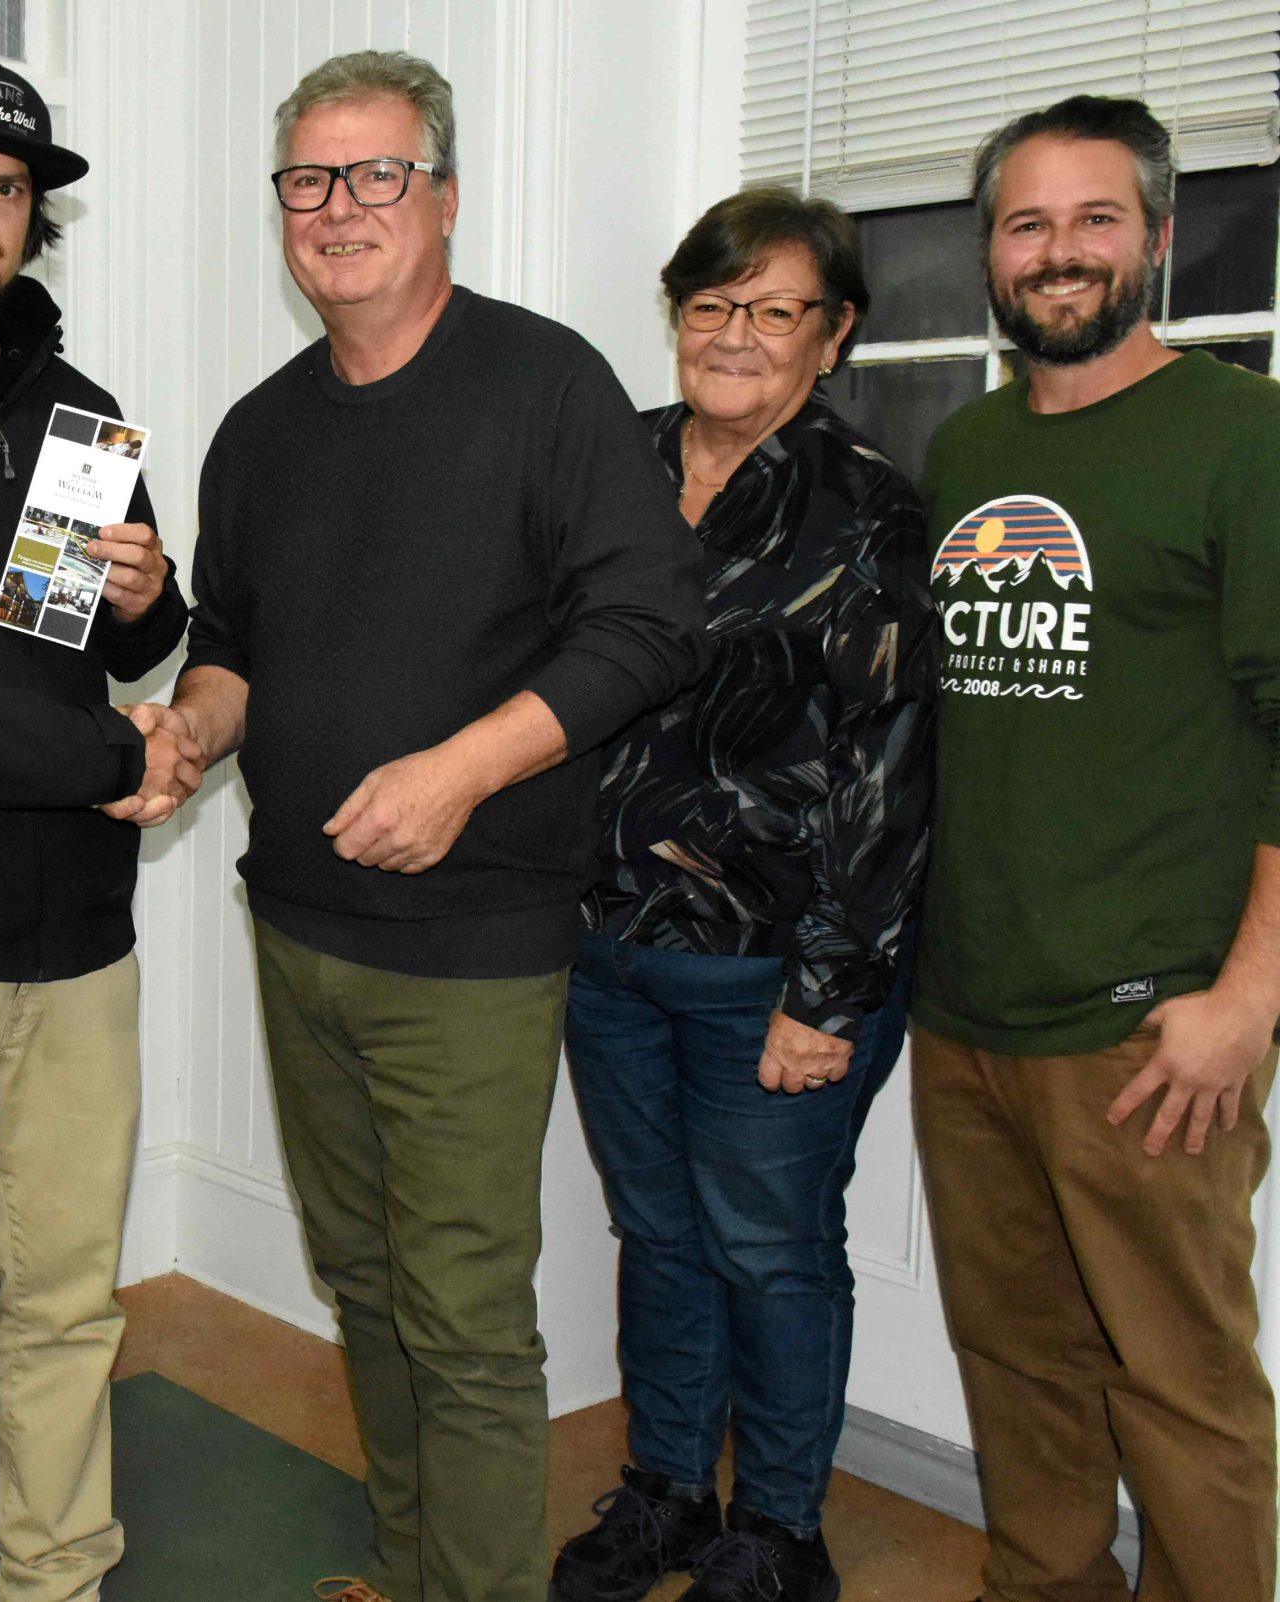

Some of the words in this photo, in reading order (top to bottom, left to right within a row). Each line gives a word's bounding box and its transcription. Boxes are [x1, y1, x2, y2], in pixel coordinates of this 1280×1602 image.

[12, 109, 36, 131] Wall
[938, 601, 1091, 652] CTURE
[948, 654, 1005, 672] PROTECT
[1013, 658, 1021, 673] &
[1027, 658, 1088, 676] SHARE
[963, 679, 1000, 697] 2008
